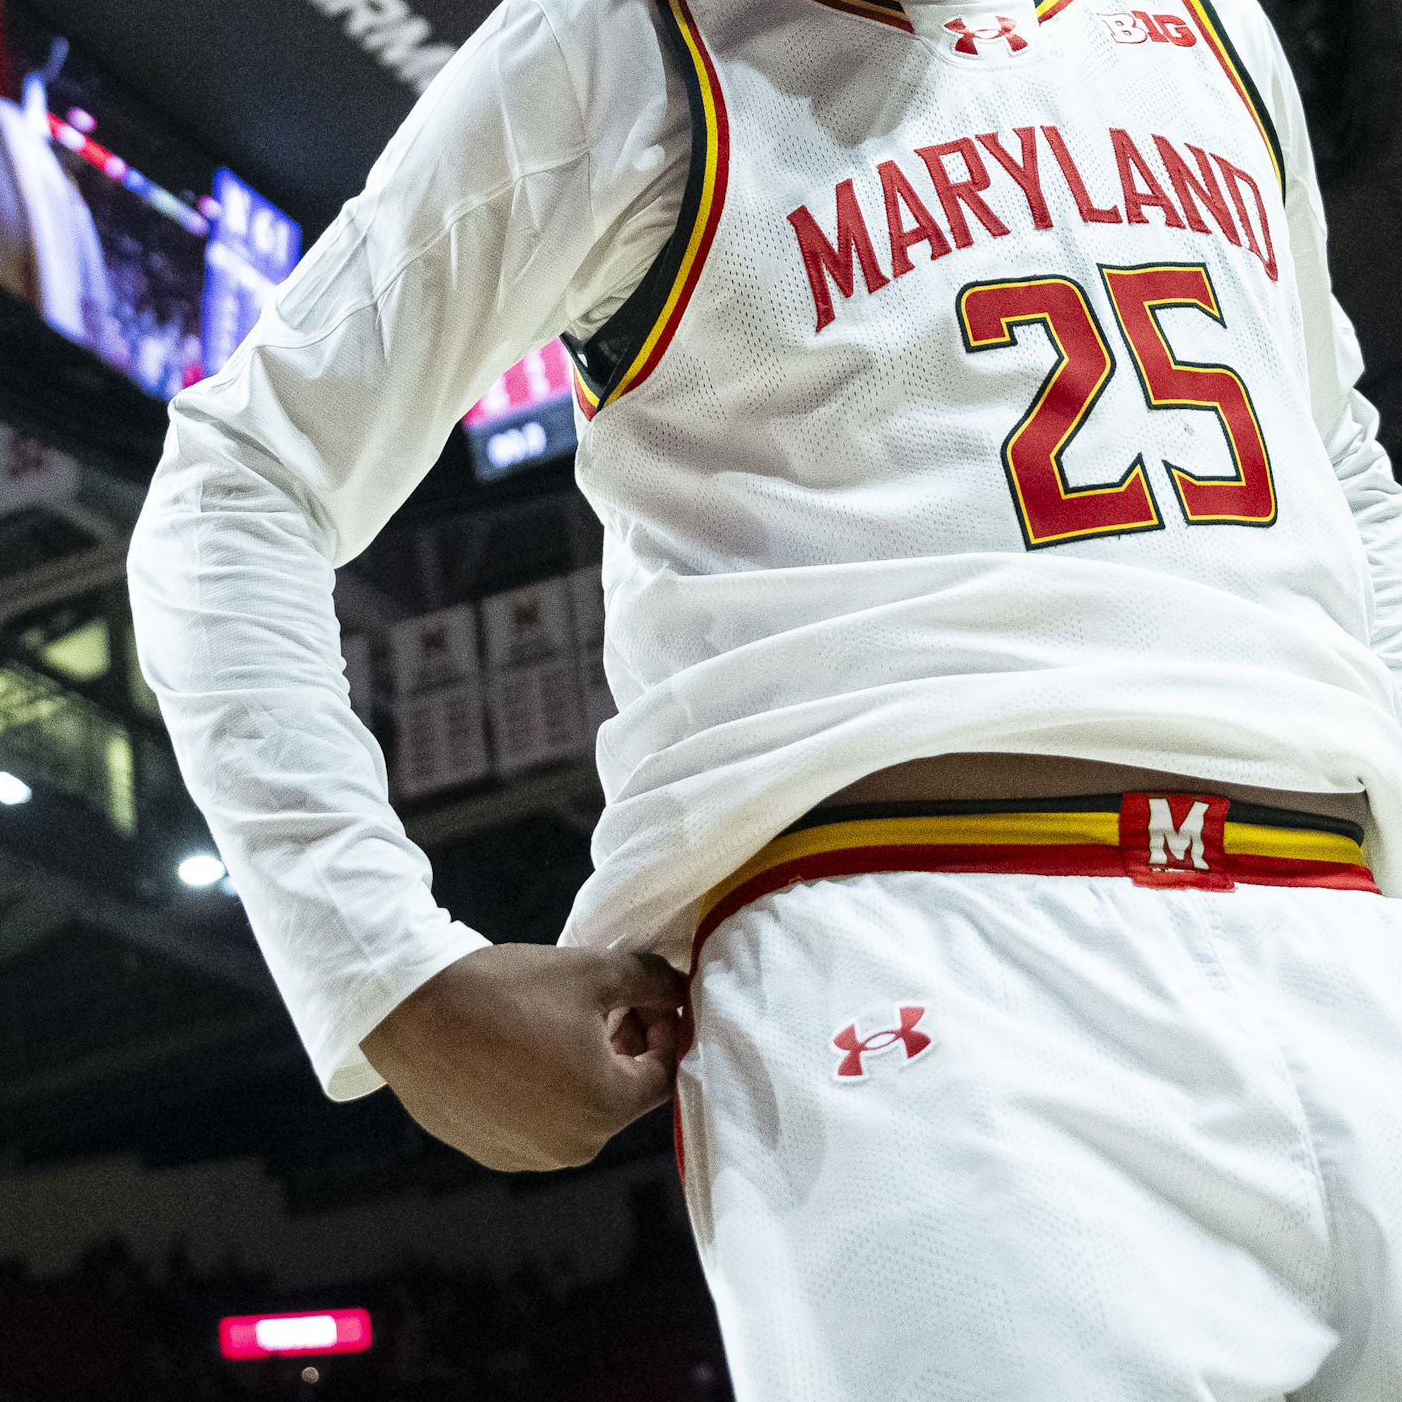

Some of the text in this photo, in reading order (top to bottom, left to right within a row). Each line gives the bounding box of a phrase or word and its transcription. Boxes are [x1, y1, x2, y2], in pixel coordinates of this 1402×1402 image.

[785, 124, 1280, 334] MARYLAND
[955, 261, 1279, 552] 25
[1147, 796, 1211, 871] M
